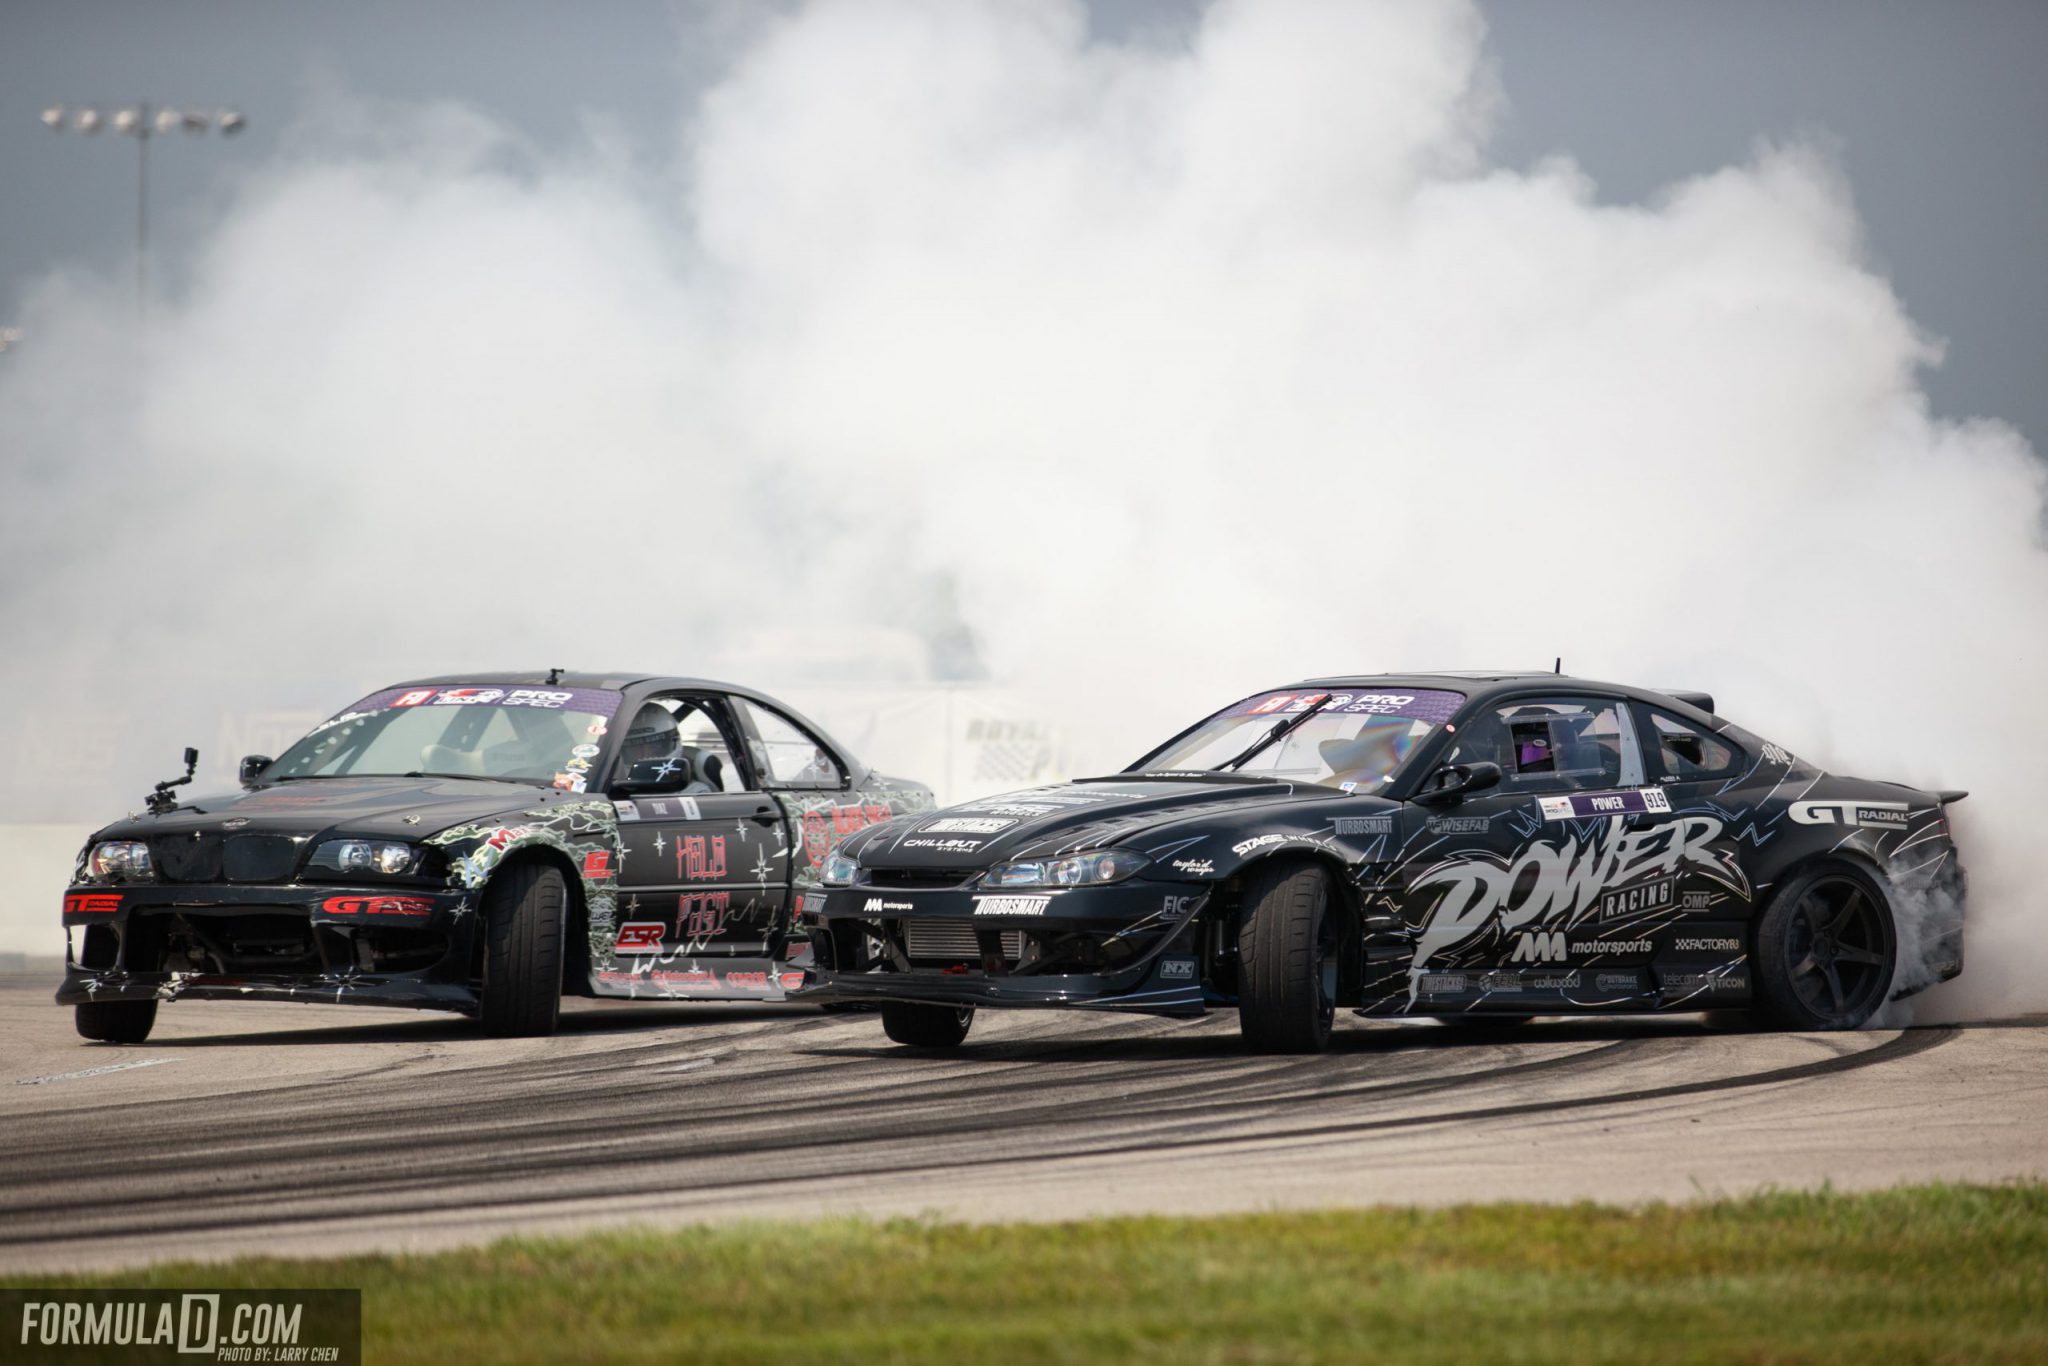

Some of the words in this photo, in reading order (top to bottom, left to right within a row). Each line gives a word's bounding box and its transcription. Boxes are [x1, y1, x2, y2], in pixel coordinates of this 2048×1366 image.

[511, 690, 573, 700] PRO
[1356, 695, 1414, 705] PRO
[502, 699, 565, 708] SPEC
[1343, 705, 1402, 713] SPEC
[1591, 796, 1625, 811] POWER
[1645, 792, 1668, 808] 919
[1788, 801, 1860, 826] GT
[1858, 810, 1908, 822] RADIAL
[1325, 816, 1393, 835] TURBOSMART
[1441, 819, 1490, 831] WISEFAB
[1232, 833, 1288, 857] STAGE
[972, 895, 1052, 915] TURBOSMART
[1163, 895, 1190, 914] FIC
[1605, 882, 1669, 917] RACING
[1682, 895, 1710, 909] OMP
[1571, 938, 1653, 956] motorsports
